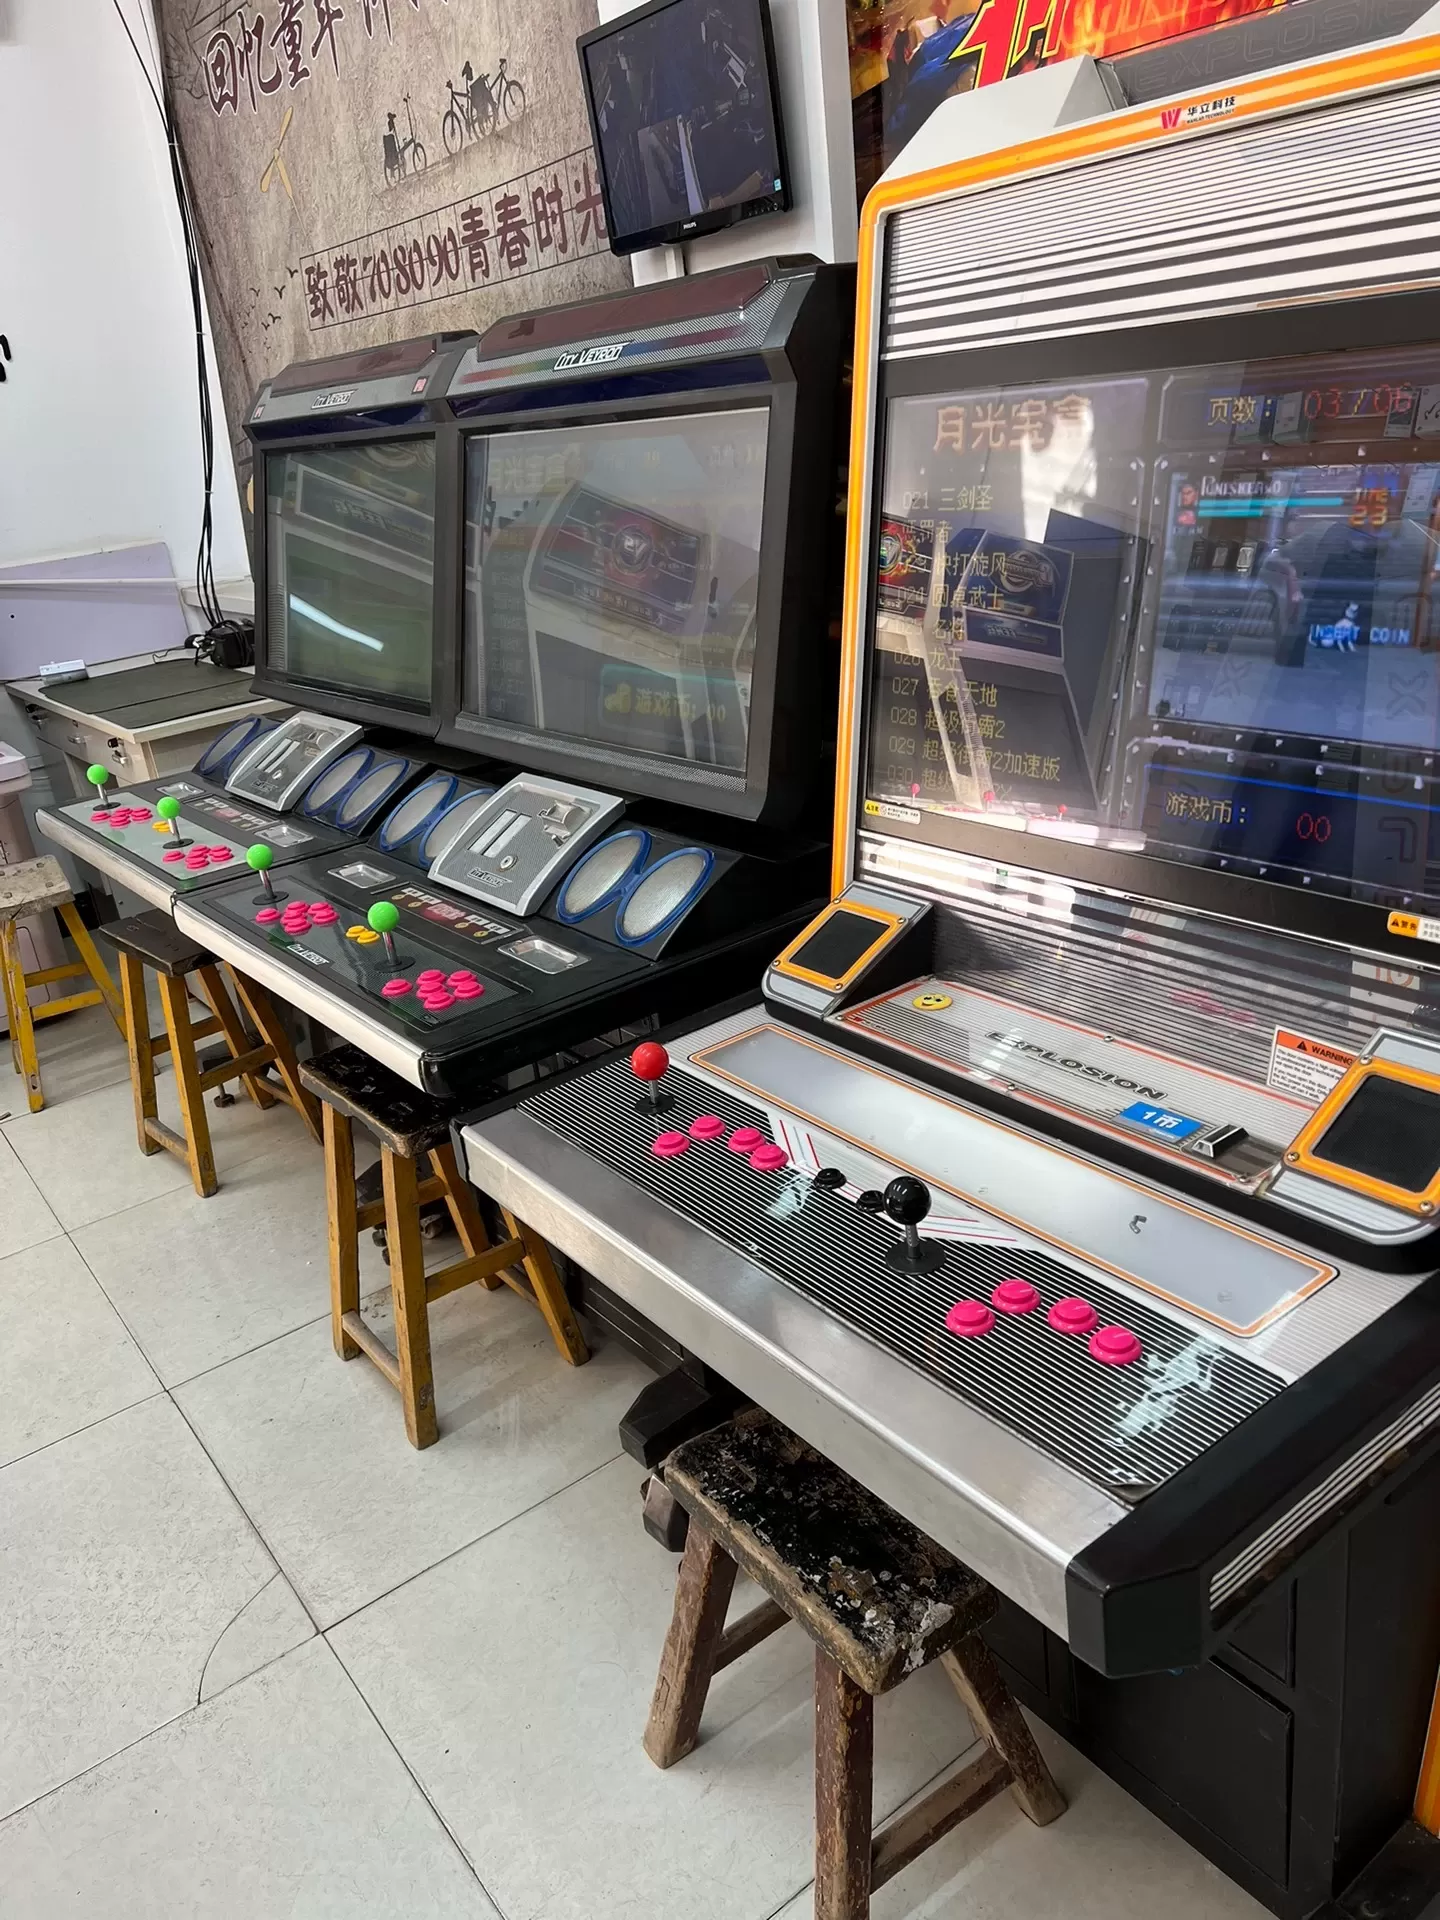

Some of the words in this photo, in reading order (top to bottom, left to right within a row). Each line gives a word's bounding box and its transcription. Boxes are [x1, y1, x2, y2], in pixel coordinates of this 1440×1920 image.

[1188, 96, 1236, 116] 华立科技
[1370, 627, 1410, 645] COIN
[892, 676, 919, 697] 027
[890, 706, 917, 727] 028
[888, 736, 916, 756] 029
[1296, 812, 1333, 843] 00
[984, 1031, 1169, 1101] EXPLOSION
[1311, 1045, 1354, 1066] WARNING
